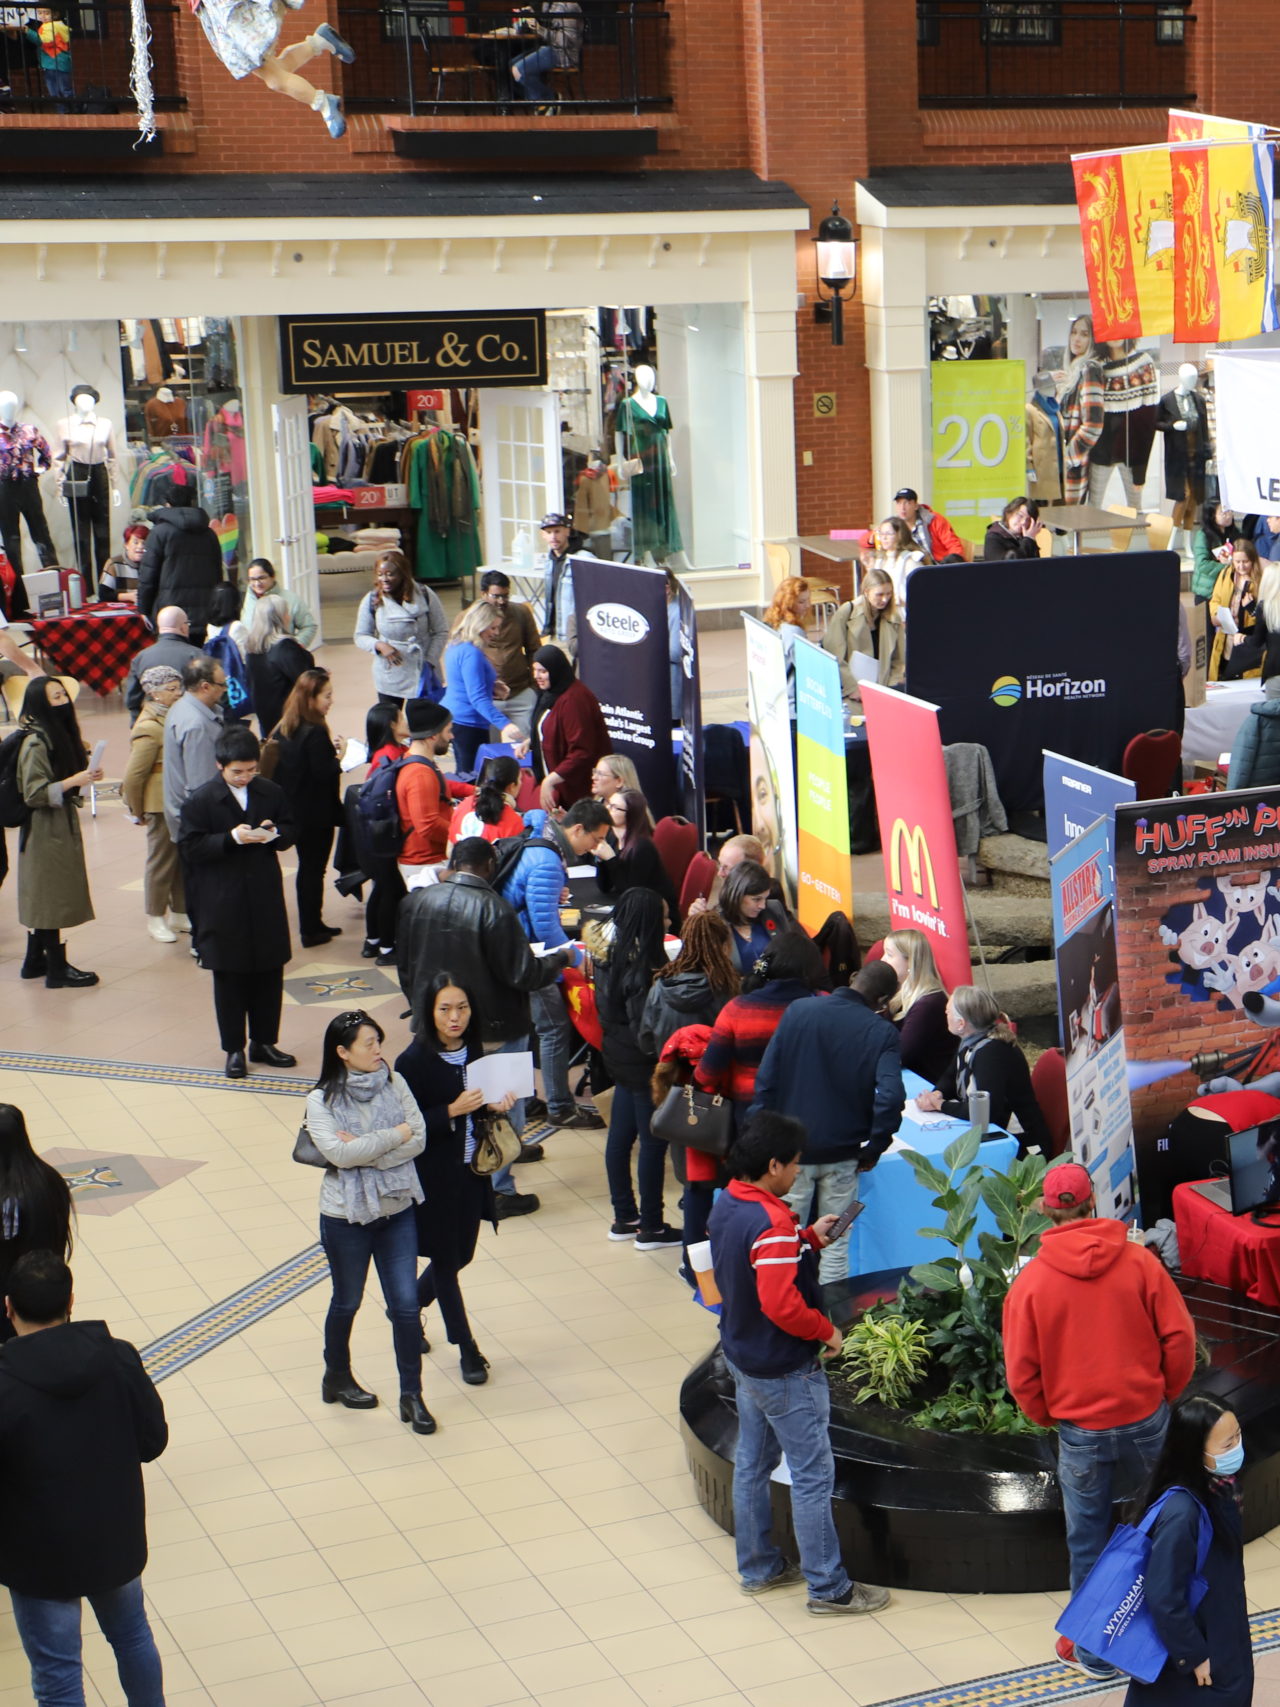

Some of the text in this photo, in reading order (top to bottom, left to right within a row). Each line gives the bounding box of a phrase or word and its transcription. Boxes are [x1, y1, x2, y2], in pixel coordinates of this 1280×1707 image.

[302, 339, 430, 368] SAMUEL
[435, 332, 472, 367] &
[597, 610, 639, 633] Steele
[1026, 678, 1106, 699] Horizon
[615, 706, 644, 721] Atlantic
[1148, 854, 1196, 874] SPRAY
[1198, 848, 1240, 867] FOAM
[892, 898, 910, 919] i'm
[1103, 1574, 1145, 1635] WYNDHAM
